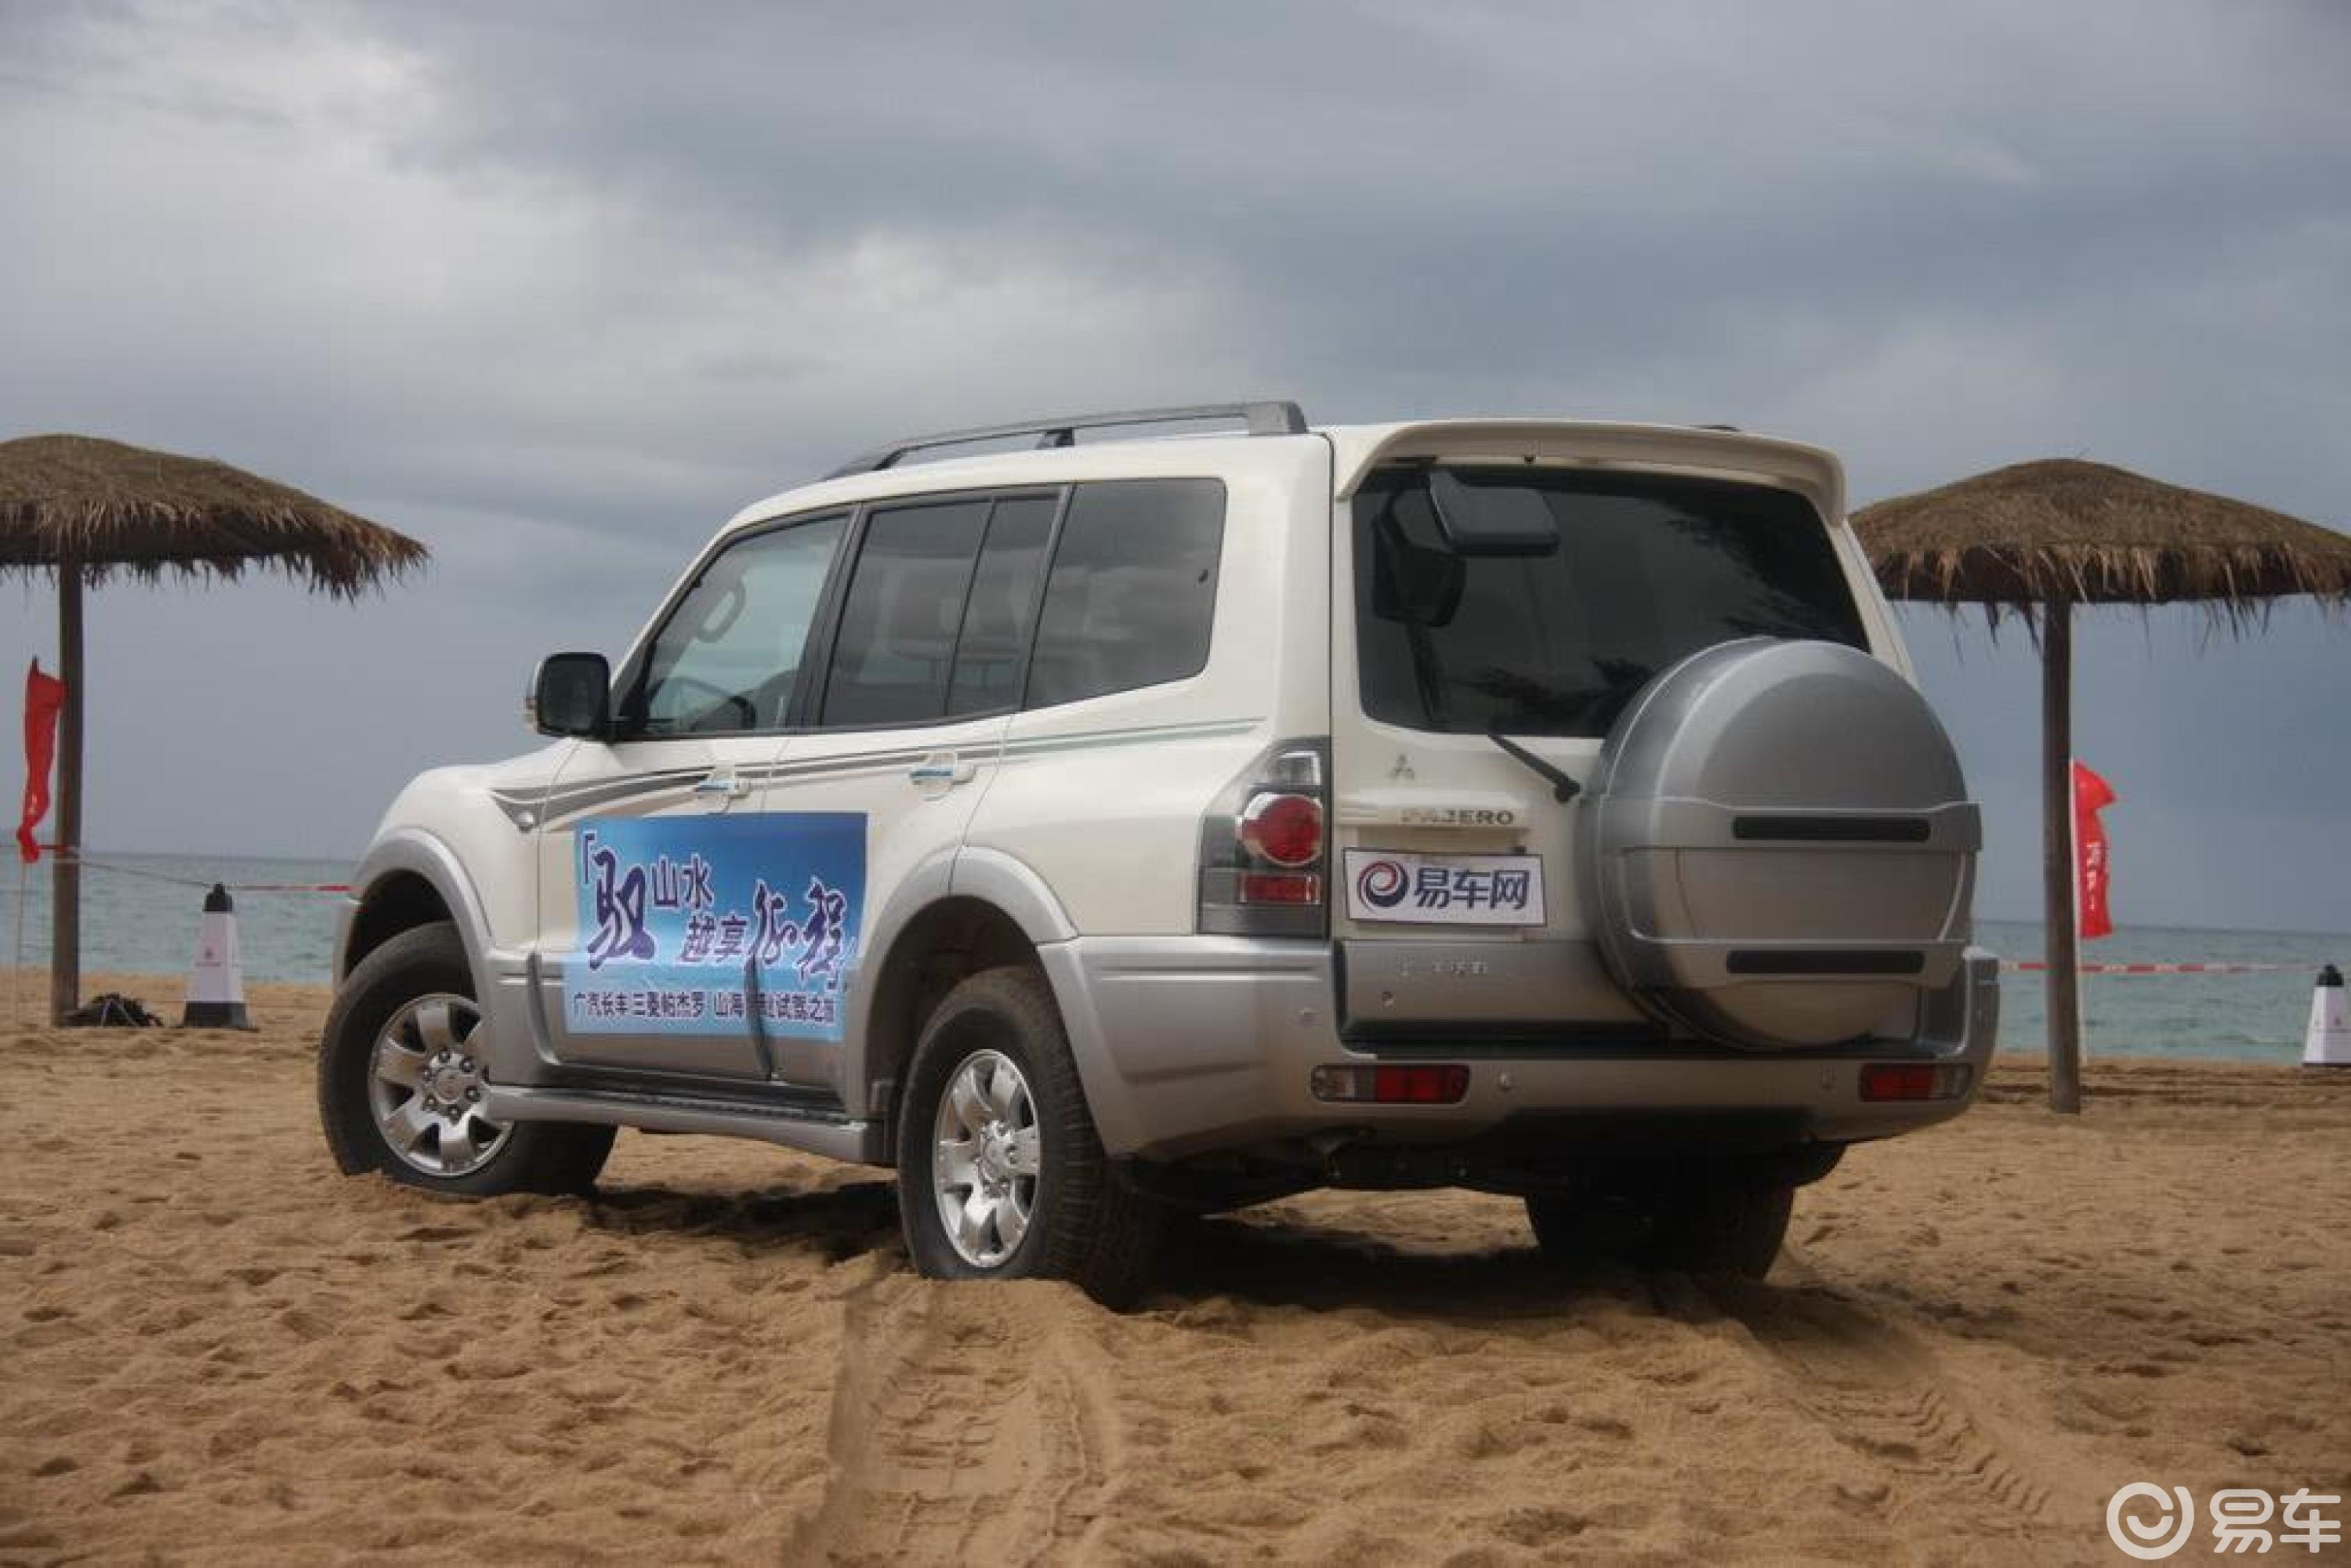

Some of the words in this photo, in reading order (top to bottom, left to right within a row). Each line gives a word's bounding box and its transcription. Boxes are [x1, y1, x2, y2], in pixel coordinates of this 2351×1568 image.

[1399, 808, 1514, 824] PAJERO
[1413, 867, 1529, 910] 易车网
